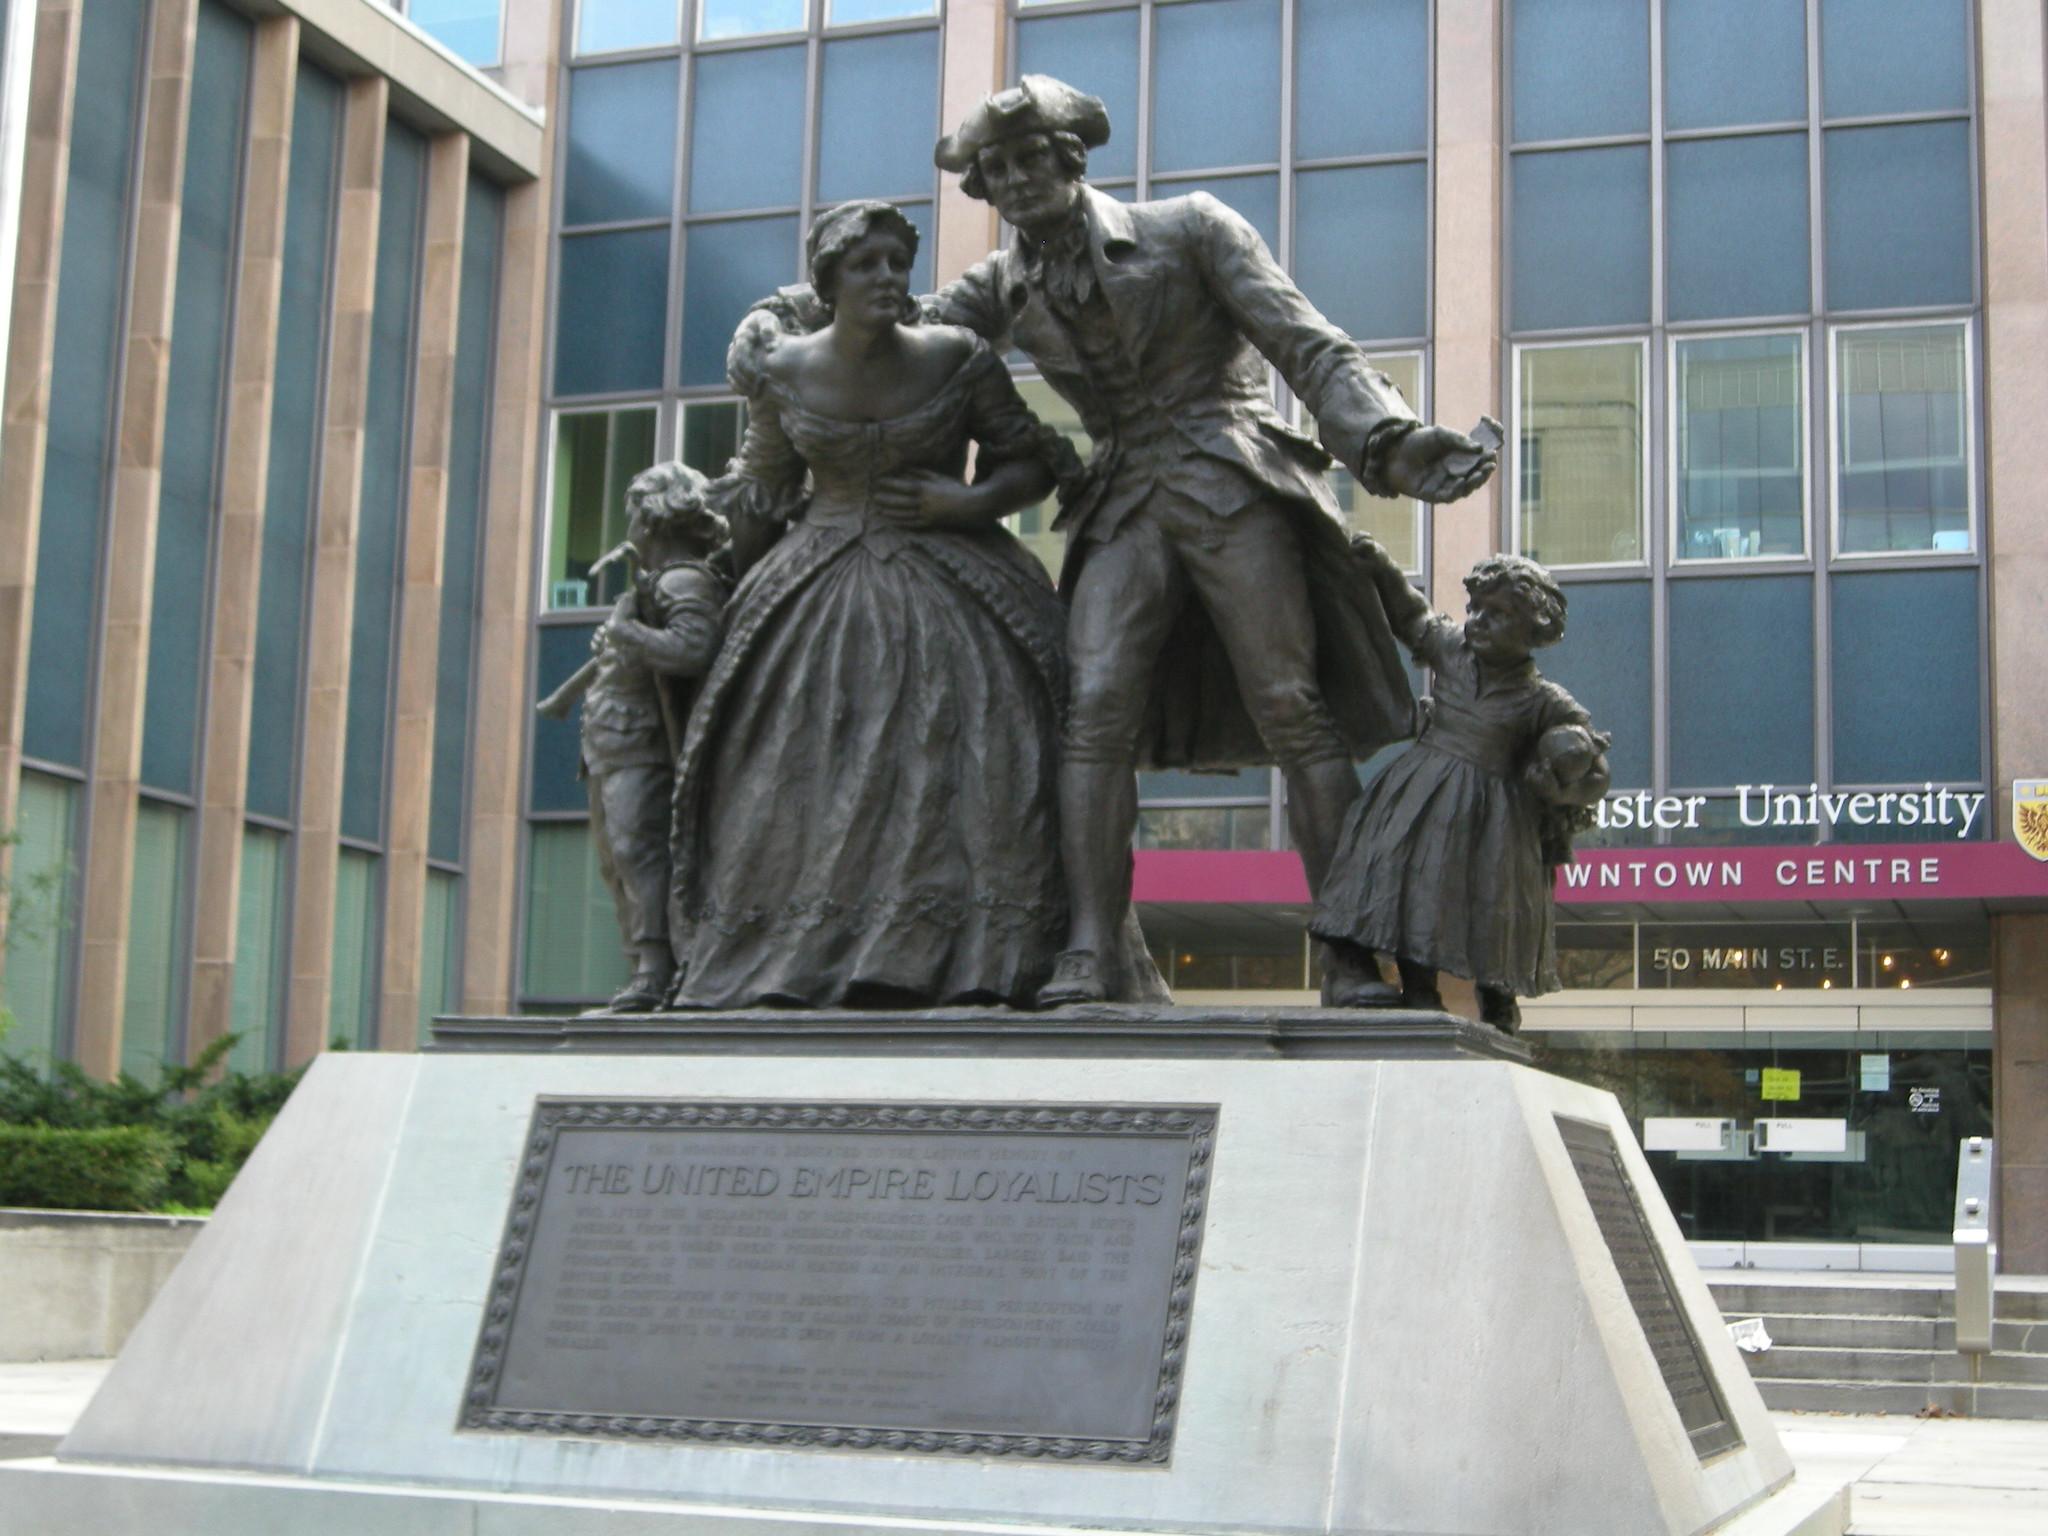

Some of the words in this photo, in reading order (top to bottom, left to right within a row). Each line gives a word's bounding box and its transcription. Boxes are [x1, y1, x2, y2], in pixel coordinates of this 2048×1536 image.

[1735, 782, 1984, 838] University
[1564, 861, 1742, 888] WNTOWN
[1776, 858, 1940, 886] CENTRE
[1654, 948, 1690, 970] 50
[1702, 948, 1768, 970] MAIN
[1780, 948, 1815, 969] ST.
[1823, 948, 1844, 968] E.
[564, 1164, 634, 1195] THE
[642, 1164, 780, 1198] UNITED
[788, 1166, 936, 1201] EMPIRE
[944, 1170, 1166, 1206] LOYALISTS
